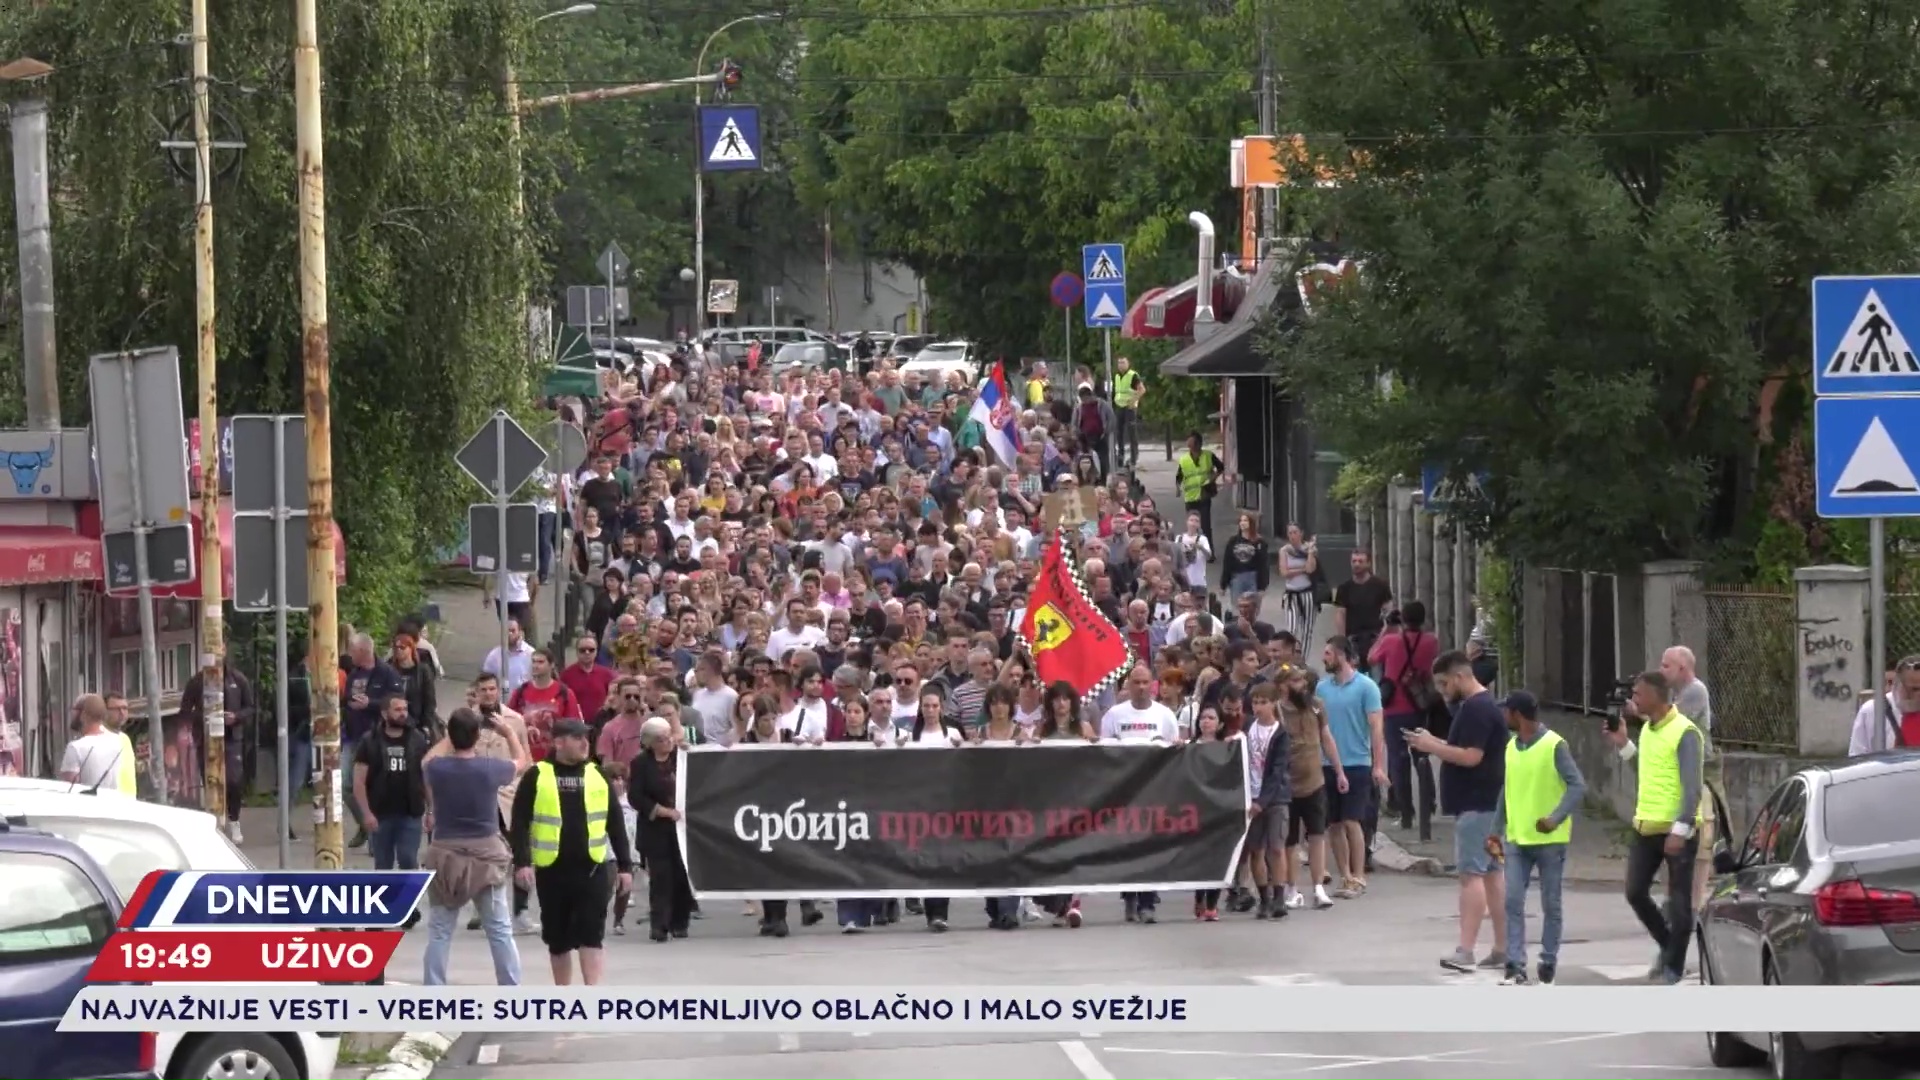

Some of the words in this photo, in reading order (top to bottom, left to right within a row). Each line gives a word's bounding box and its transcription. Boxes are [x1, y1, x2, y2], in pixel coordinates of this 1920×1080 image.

[733, 798, 871, 852] Србија
[879, 807, 1035, 849] против
[1044, 803, 1200, 837] насиља
